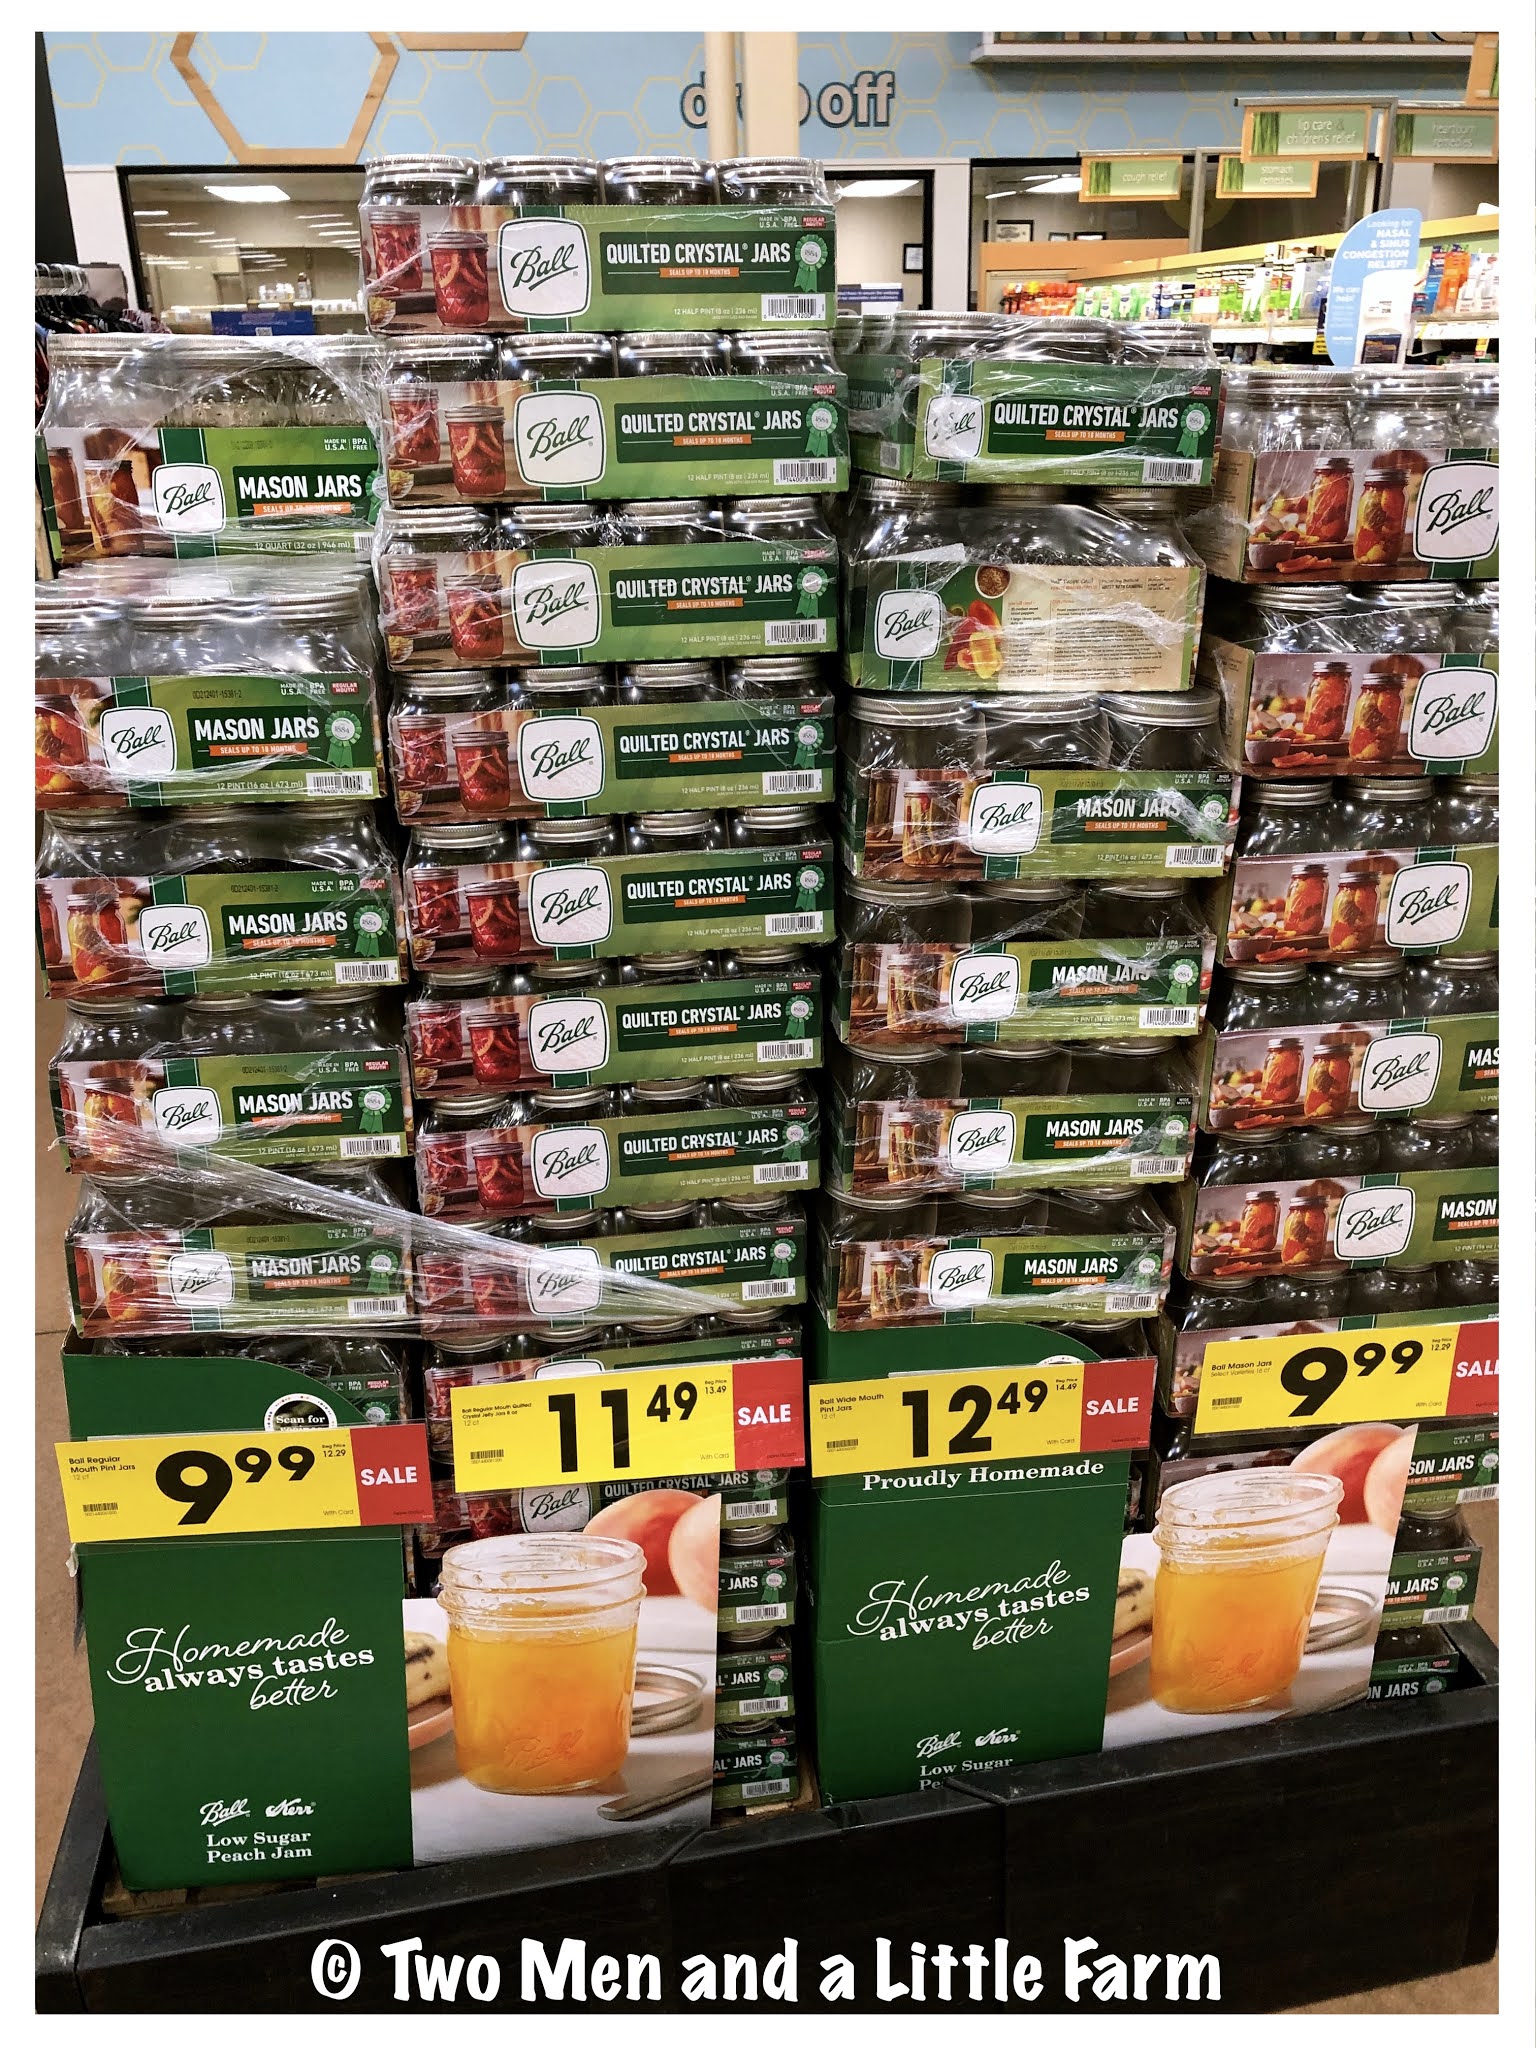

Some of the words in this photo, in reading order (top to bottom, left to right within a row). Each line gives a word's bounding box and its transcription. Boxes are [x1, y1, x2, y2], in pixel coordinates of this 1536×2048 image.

[818, 70, 895, 128] off
[1377, 229, 1411, 237] NASAL
[607, 242, 670, 264] QUILTED
[751, 242, 790, 262] JARS
[1342, 250, 1409, 259] CONGESTION
[511, 244, 579, 290] Ball
[994, 402, 1059, 426] QUILTED
[1137, 407, 1178, 429] JARS
[163, 482, 214, 517] Ball
[239, 475, 308, 500] MASON
[314, 475, 362, 498] JARS
[1426, 486, 1494, 535] Ball
[884, 609, 933, 642] Ball
[195, 718, 268, 741] MASON
[273, 717, 320, 738] JARS
[619, 733, 678, 755] QUILTED
[754, 728, 790, 747] JARS
[530, 737, 594, 780] Ball
[622, 1010, 678, 1029] QUILTED
[747, 1003, 781, 1020] JARS
[539, 1015, 597, 1054] Ball
[239, 1093, 303, 1114] MASON
[308, 1091, 353, 1110] JARS
[162, 1100, 212, 1130] Ball
[1046, 1120, 1099, 1138] MASON
[1104, 1118, 1144, 1136] JARS
[957, 1125, 1007, 1156] Ball
[1345, 1203, 1404, 1237] Ball
[1441, 1198, 1496, 1219] MASON
[1431, 1343, 1451, 1351] 12.29
[705, 1385, 727, 1395] 13.49
[820, 1397, 834, 1405] Ball
[836, 1395, 857, 1403] Wide
[859, 1393, 884, 1401] Mouth
[1055, 1383, 1077, 1391] 14.49
[738, 1404, 791, 1426] SALE
[836, 1404, 852, 1412] Jars
[1086, 1397, 1139, 1416] SALE
[276, 1415, 304, 1425] Scan
[308, 1414, 325, 1424] for
[87, 1456, 120, 1464] Regular
[322, 1449, 346, 1458] 12.29
[1439, 1454, 1475, 1472] JARS
[71, 1465, 98, 1473] Mouth
[101, 1464, 116, 1472] Pint
[361, 1466, 418, 1486] SALE
[863, 1469, 962, 1491] Proudly
[969, 1460, 1104, 1484] Homemade
[847, 1560, 1072, 1636] Homemade
[880, 1604, 989, 1642] always
[999, 1586, 1090, 1618] tastes
[972, 1617, 1054, 1651] better
[107, 1617, 350, 1685] Homemade
[145, 1664, 264, 1693] always
[272, 1649, 375, 1676] tastes
[730, 1671, 761, 1685] JARS
[249, 1676, 338, 1710] better
[916, 1730, 962, 1759] Ball
[919, 1763, 957, 1777] Low
[961, 1757, 1013, 1773] Sugar
[200, 1798, 251, 1827] Ball
[206, 1833, 248, 1847] Low
[253, 1831, 311, 1846] Sugar
[206, 1848, 266, 1863] Peach
[271, 1846, 312, 1859] Jam
